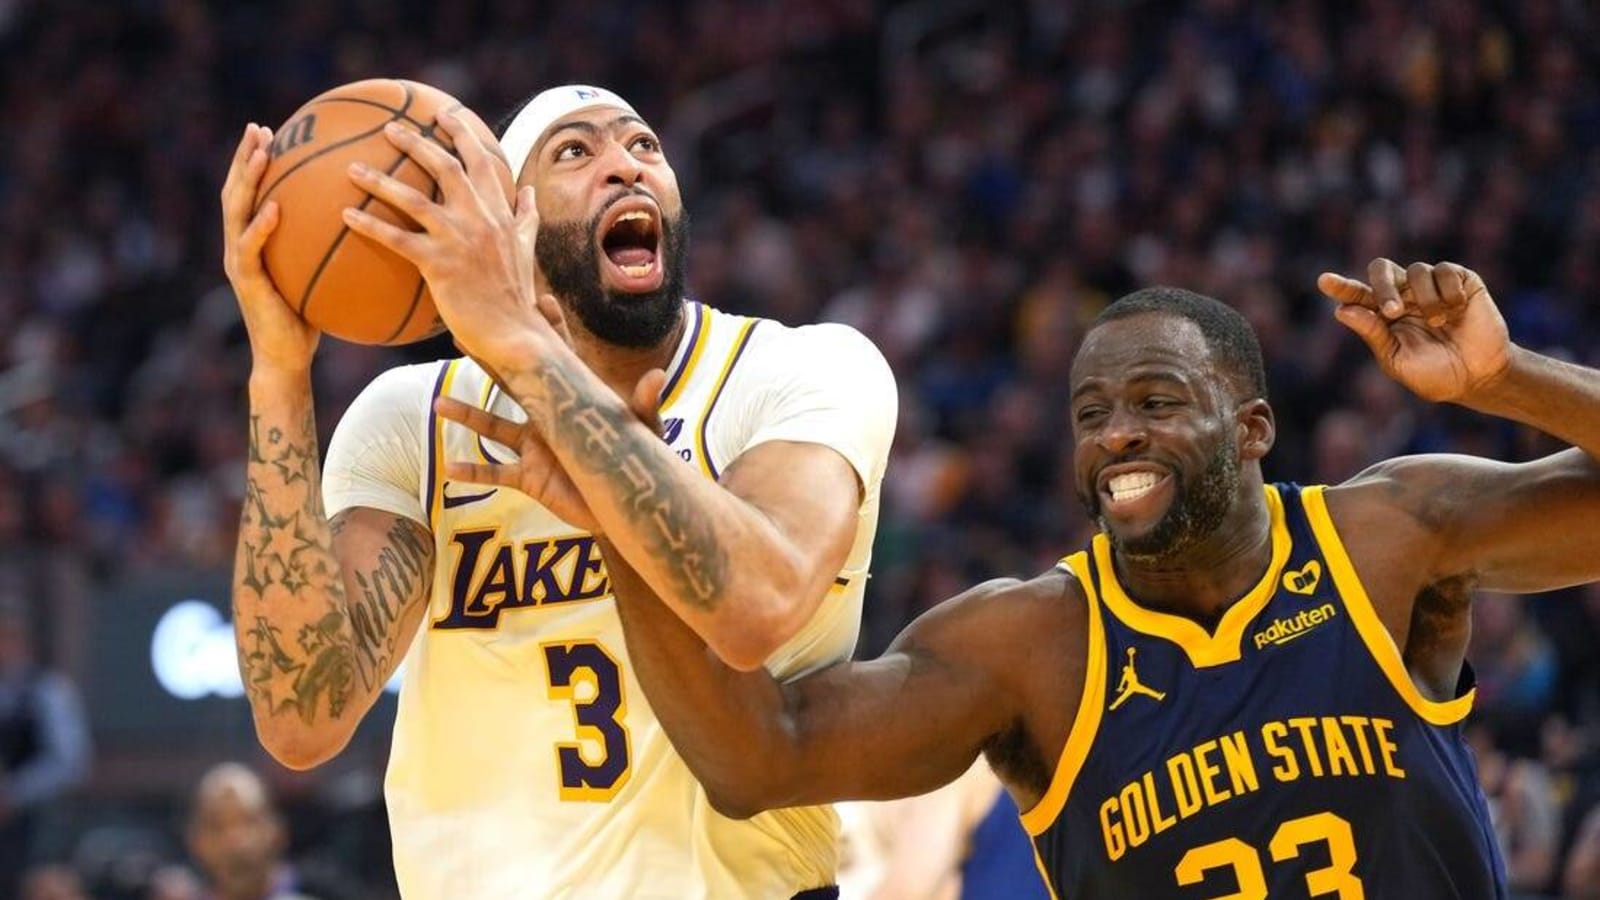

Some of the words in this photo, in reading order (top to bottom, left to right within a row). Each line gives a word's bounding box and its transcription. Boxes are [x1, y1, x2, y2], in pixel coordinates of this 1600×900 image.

[432, 529, 615, 631] LAKE
[1253, 603, 1336, 650] Rakuten
[539, 640, 632, 803] 3
[1099, 730, 1260, 862] GOLDEN
[1261, 715, 1406, 783] STATE
